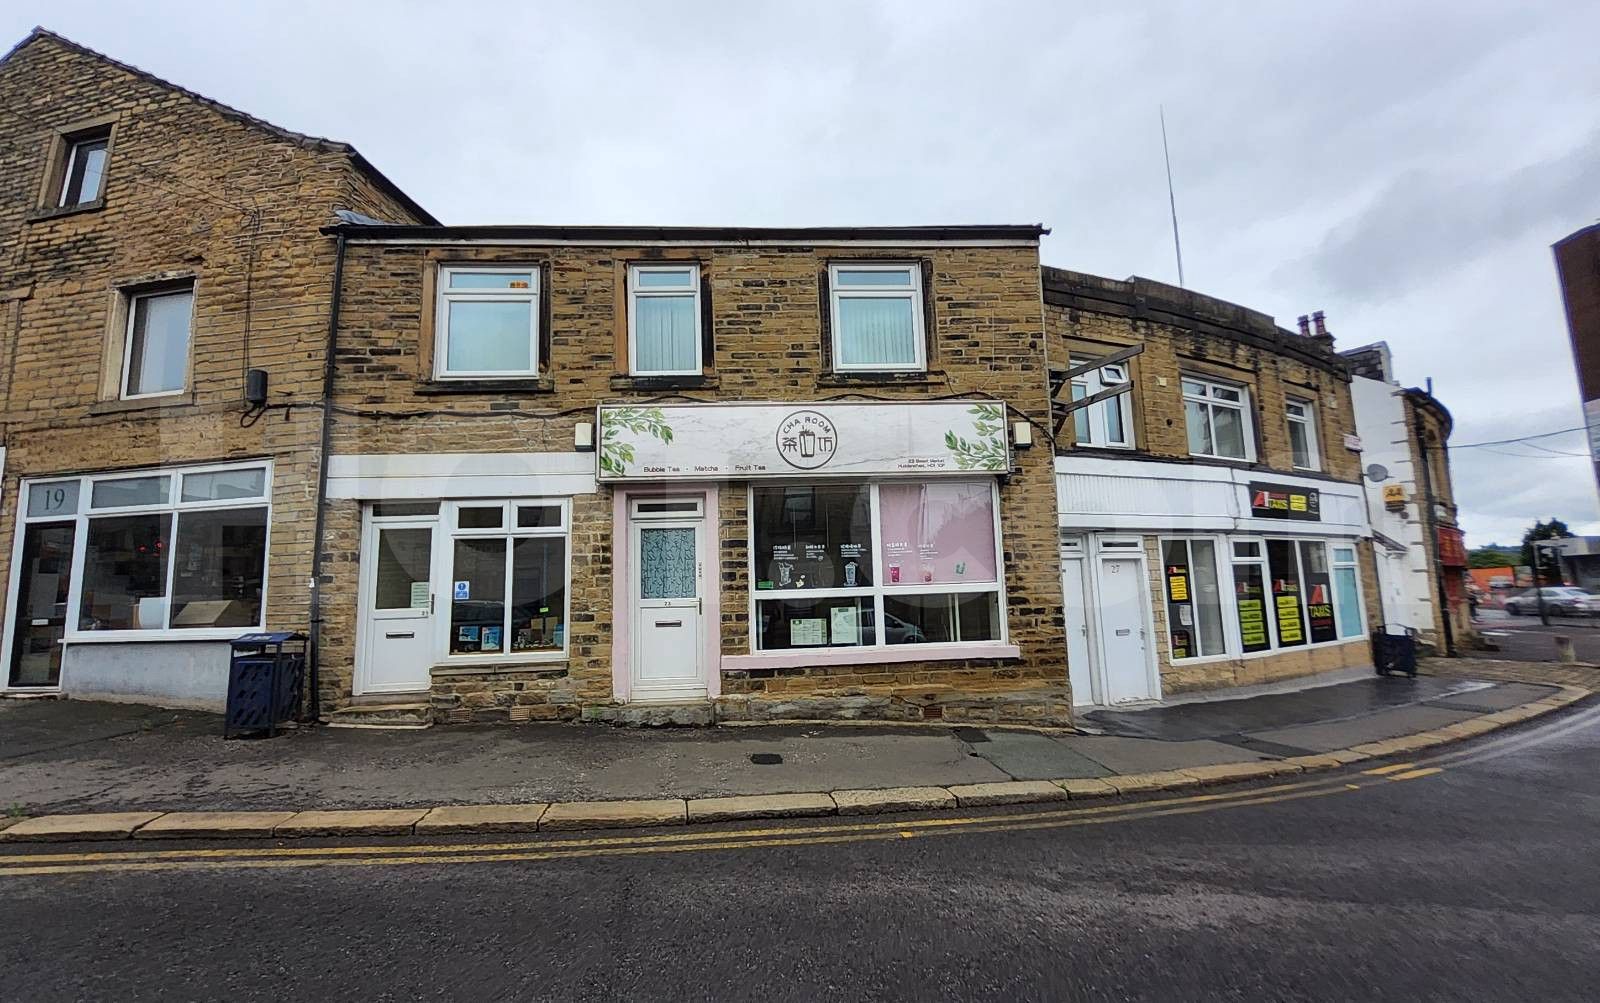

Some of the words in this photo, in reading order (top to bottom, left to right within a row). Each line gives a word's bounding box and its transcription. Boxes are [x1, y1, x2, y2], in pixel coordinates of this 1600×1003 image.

[783, 418, 801, 434] CHA
[804, 416, 831, 434] ROOM
[781, 436, 798, 453] 茶
[44, 488, 65, 511] 19
